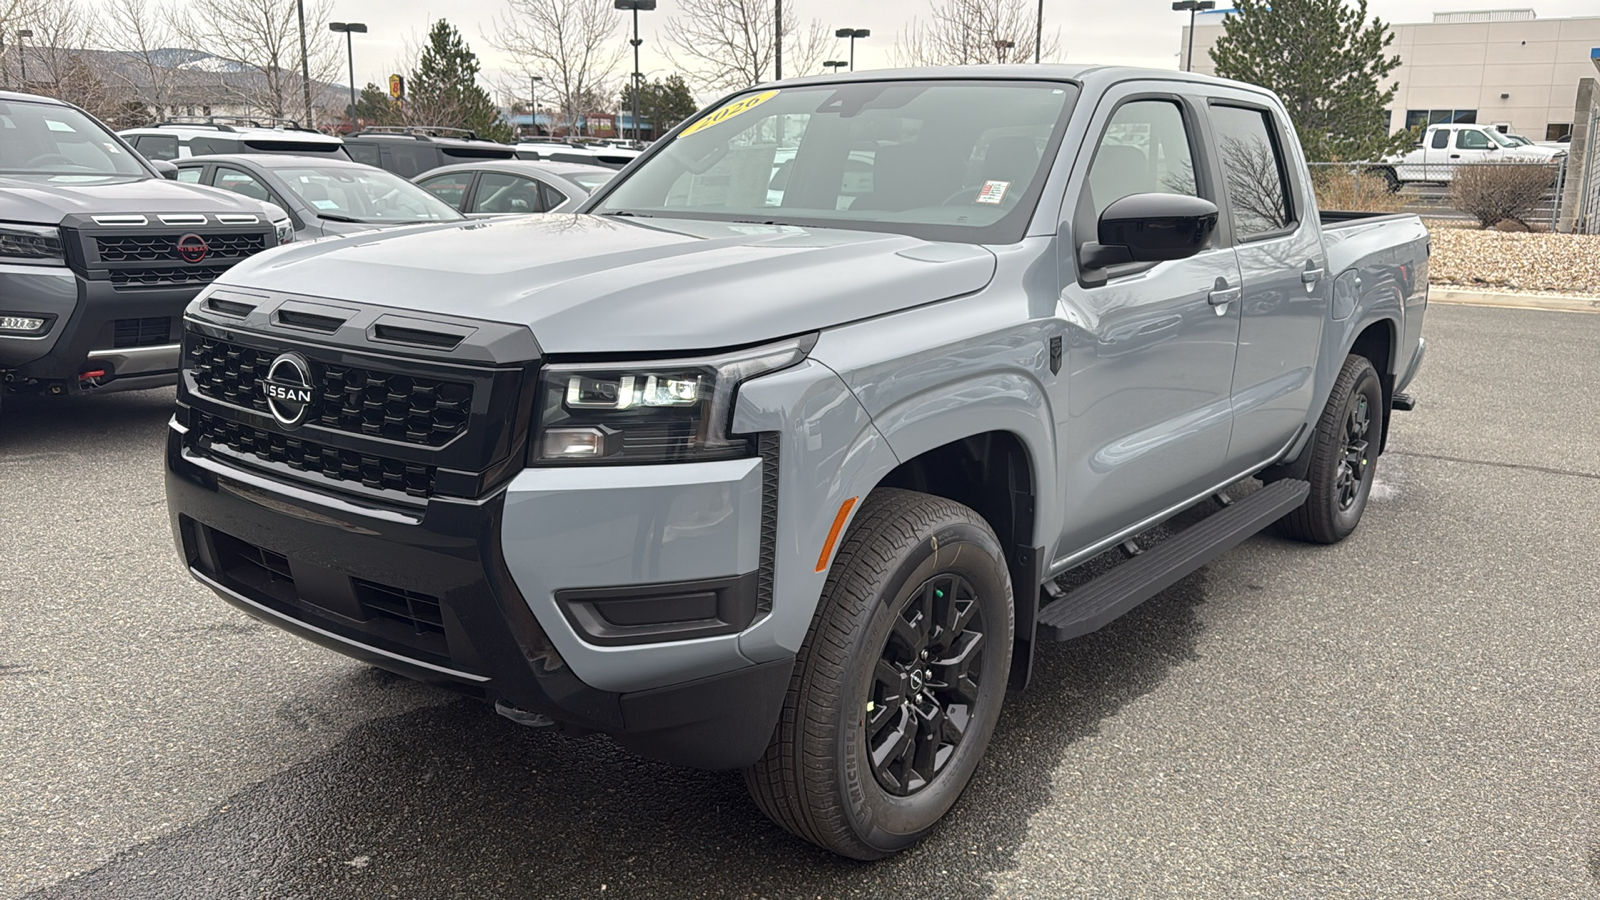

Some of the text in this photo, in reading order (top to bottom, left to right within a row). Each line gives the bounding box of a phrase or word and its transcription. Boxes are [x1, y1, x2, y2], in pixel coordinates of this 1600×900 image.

[393, 82, 399, 93] 8
[695, 97, 760, 132] 2026
[177, 244, 209, 252] NISSAN
[263, 381, 311, 403] NISSAN
[846, 704, 862, 804] MICHELIN
